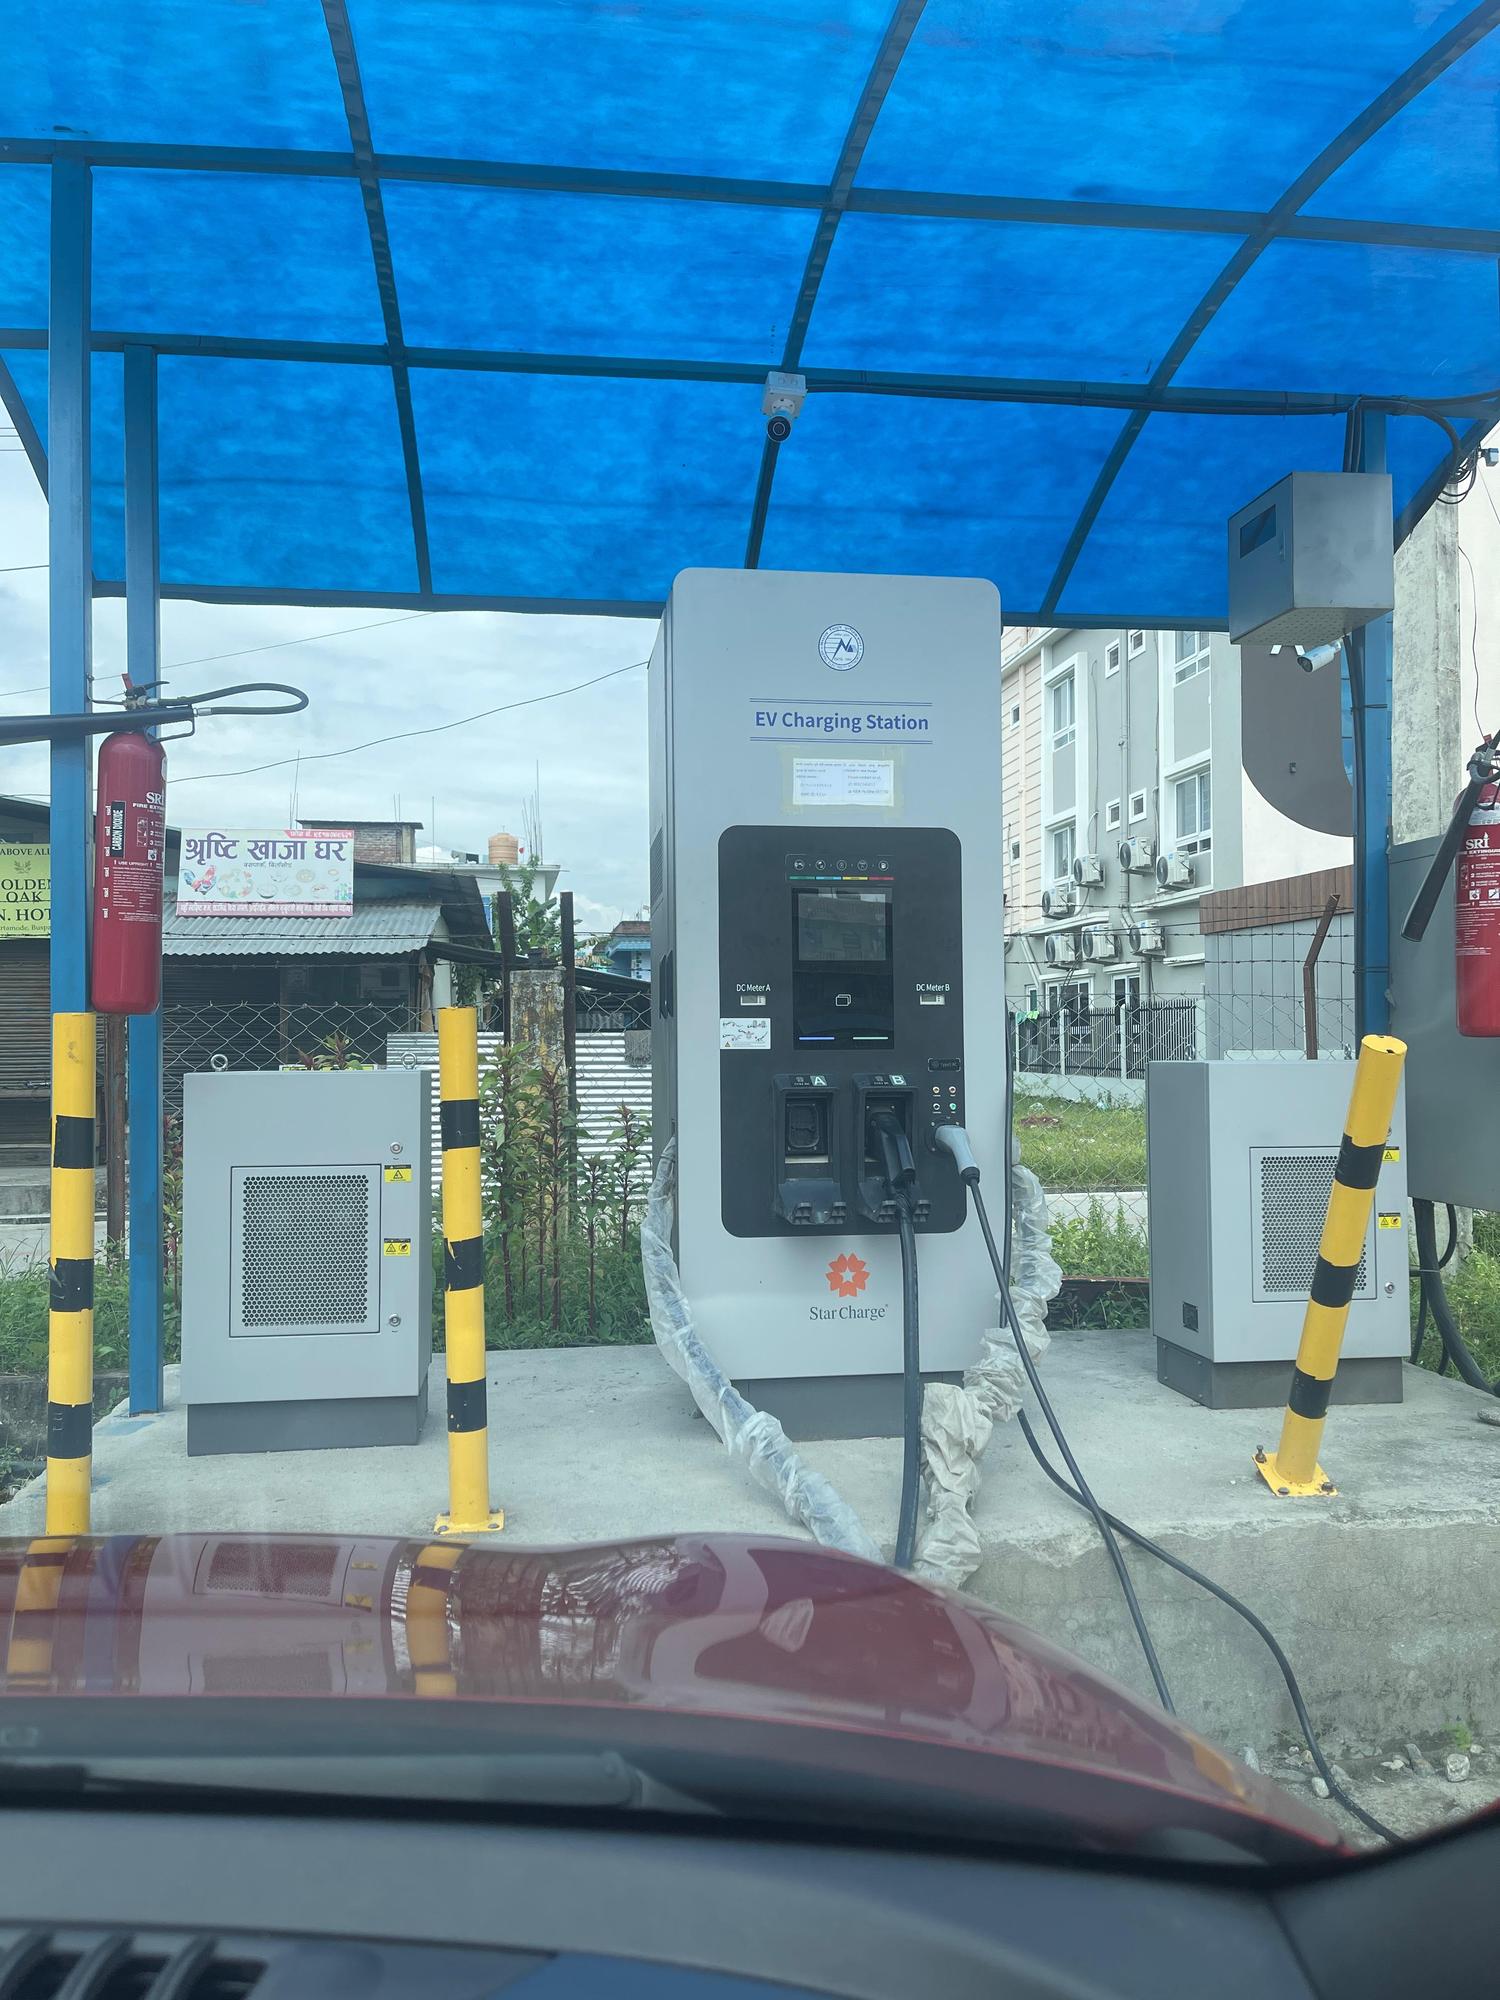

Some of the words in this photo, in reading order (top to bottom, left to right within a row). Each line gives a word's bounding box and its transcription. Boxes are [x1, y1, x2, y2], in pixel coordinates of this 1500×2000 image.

[756, 711, 778, 727] EV
[782, 711, 862, 733] Charging
[866, 714, 929, 730] Station
[0, 848, 33, 856] ABOVE
[247, 840, 307, 861] खाजा
[314, 841, 348, 861] घर
[6, 891, 42, 903] OAK
[736, 983, 746, 992] DC
[746, 983, 765, 992] Meter
[765, 983, 771, 992] A
[916, 983, 925, 992] DC
[926, 983, 945, 992] Meter
[945, 983, 950, 992] B
[814, 1076, 826, 1086] A
[891, 1075, 904, 1086] B
[809, 1306, 837, 1320] Star
[839, 1305, 886, 1321] Charge
